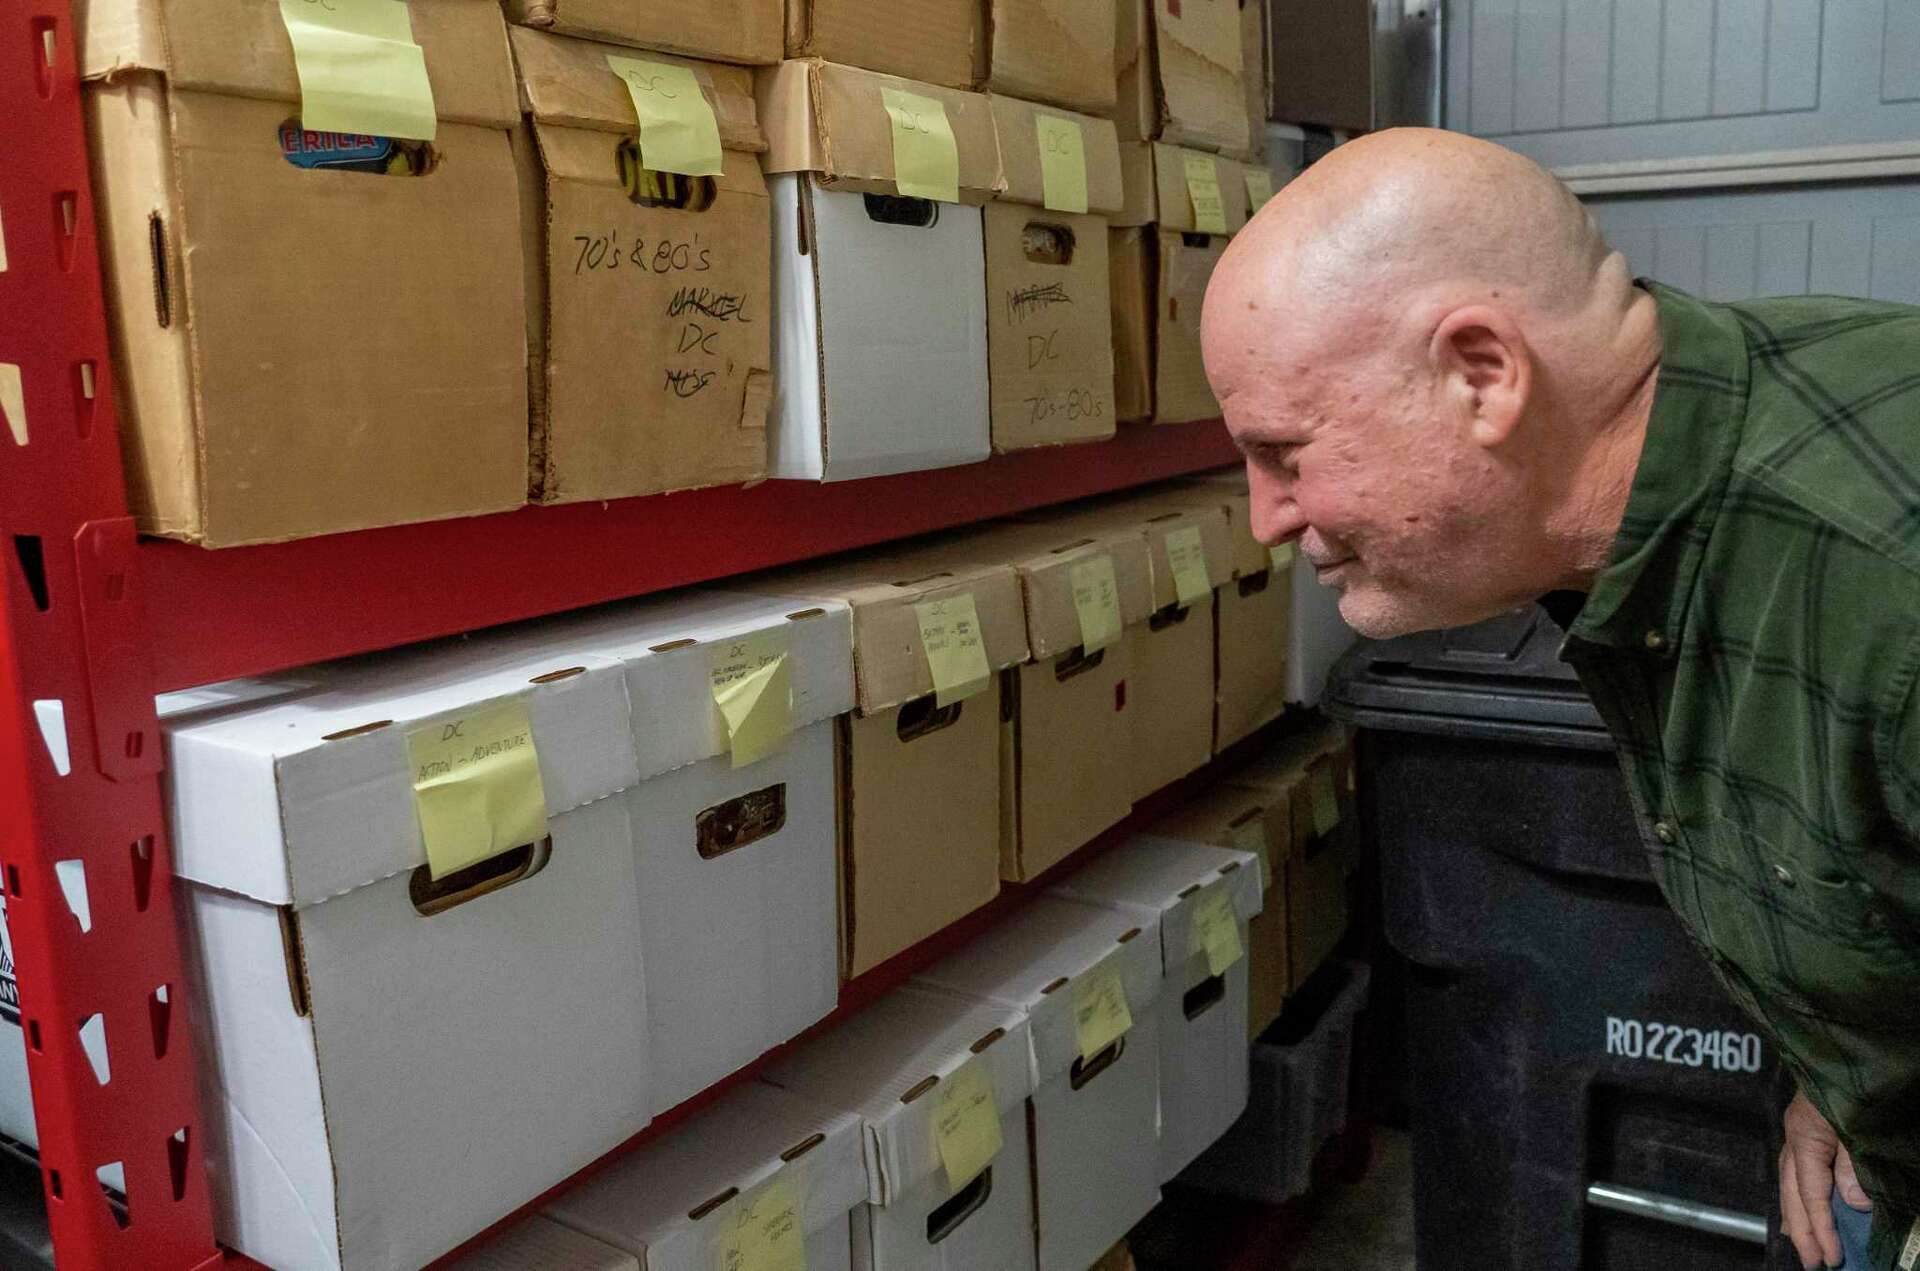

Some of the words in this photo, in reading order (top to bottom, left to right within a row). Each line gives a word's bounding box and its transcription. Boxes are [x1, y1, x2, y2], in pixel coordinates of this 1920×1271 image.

[899, 105, 929, 134] DC
[1047, 129, 1068, 155] DC
[574, 229, 622, 275] 70's
[630, 238, 647, 271] &
[652, 232, 711, 274] 80's
[678, 323, 718, 355] DC
[1028, 329, 1059, 369] DC
[442, 720, 464, 741] DC
